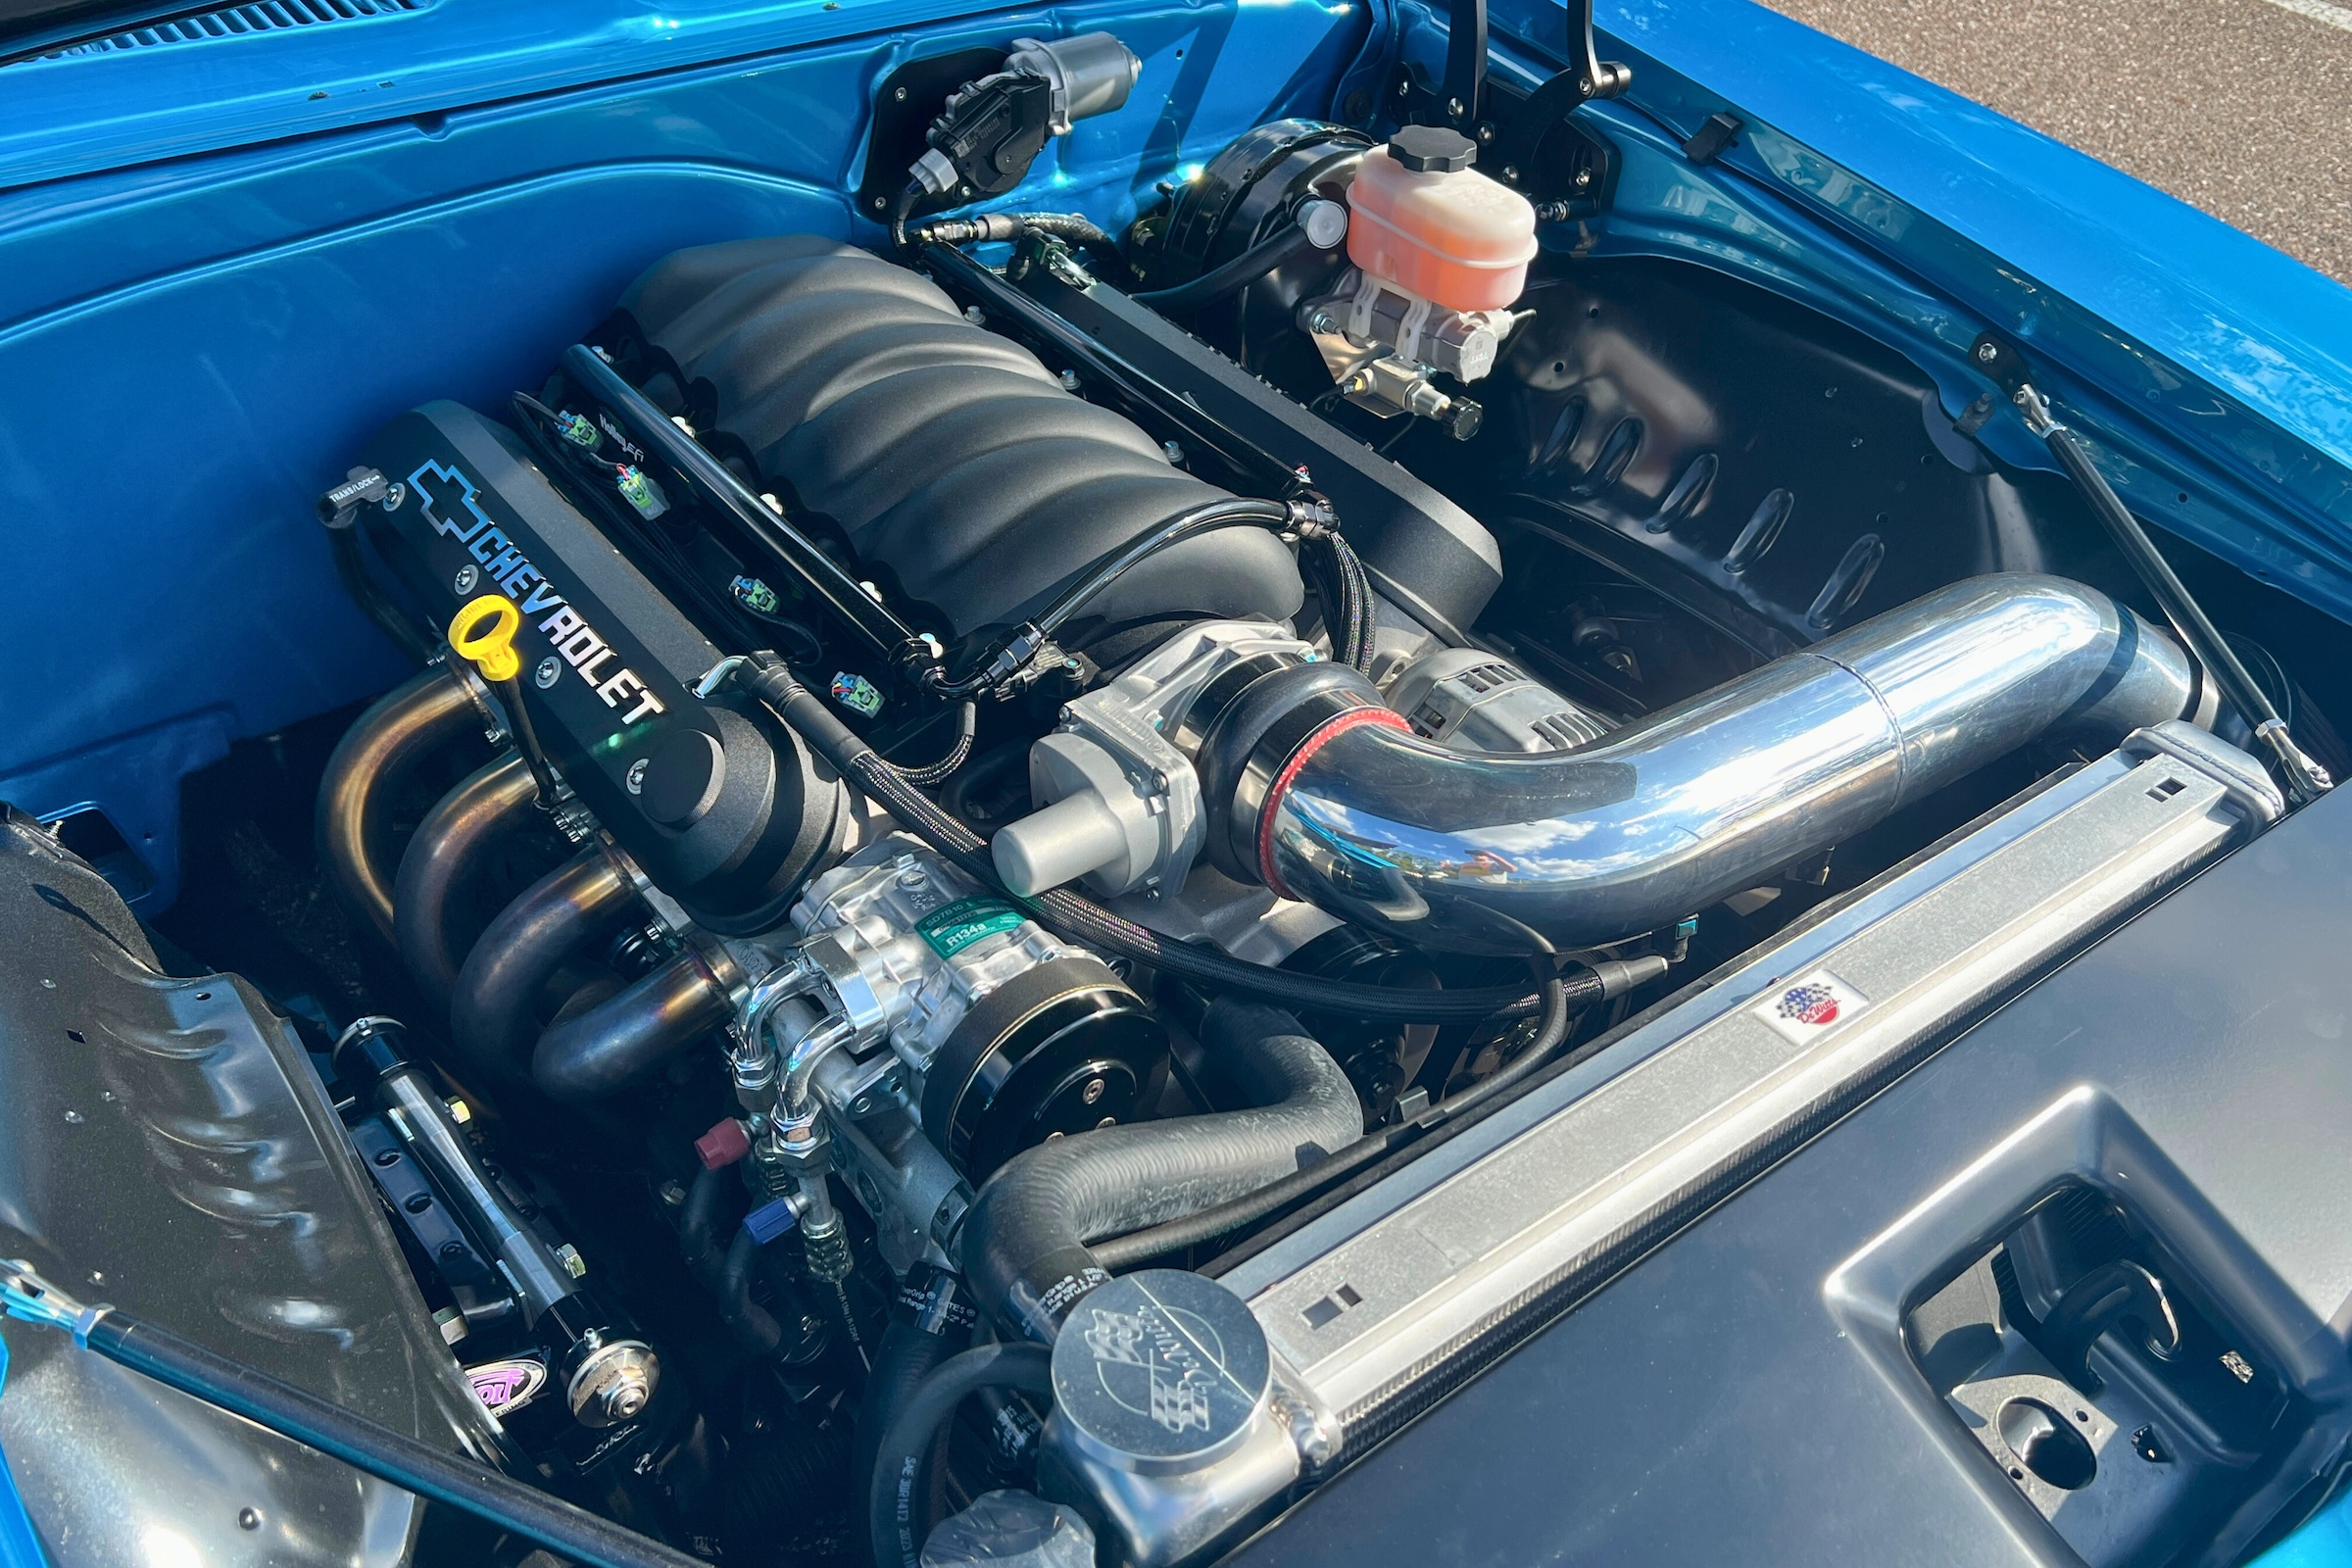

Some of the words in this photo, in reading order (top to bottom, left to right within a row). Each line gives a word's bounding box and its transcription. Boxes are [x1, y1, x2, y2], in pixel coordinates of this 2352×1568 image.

[467, 526, 666, 725] CHEVROLET
[945, 922, 988, 948] R134a
[1795, 998, 1841, 1024] DeWitts
